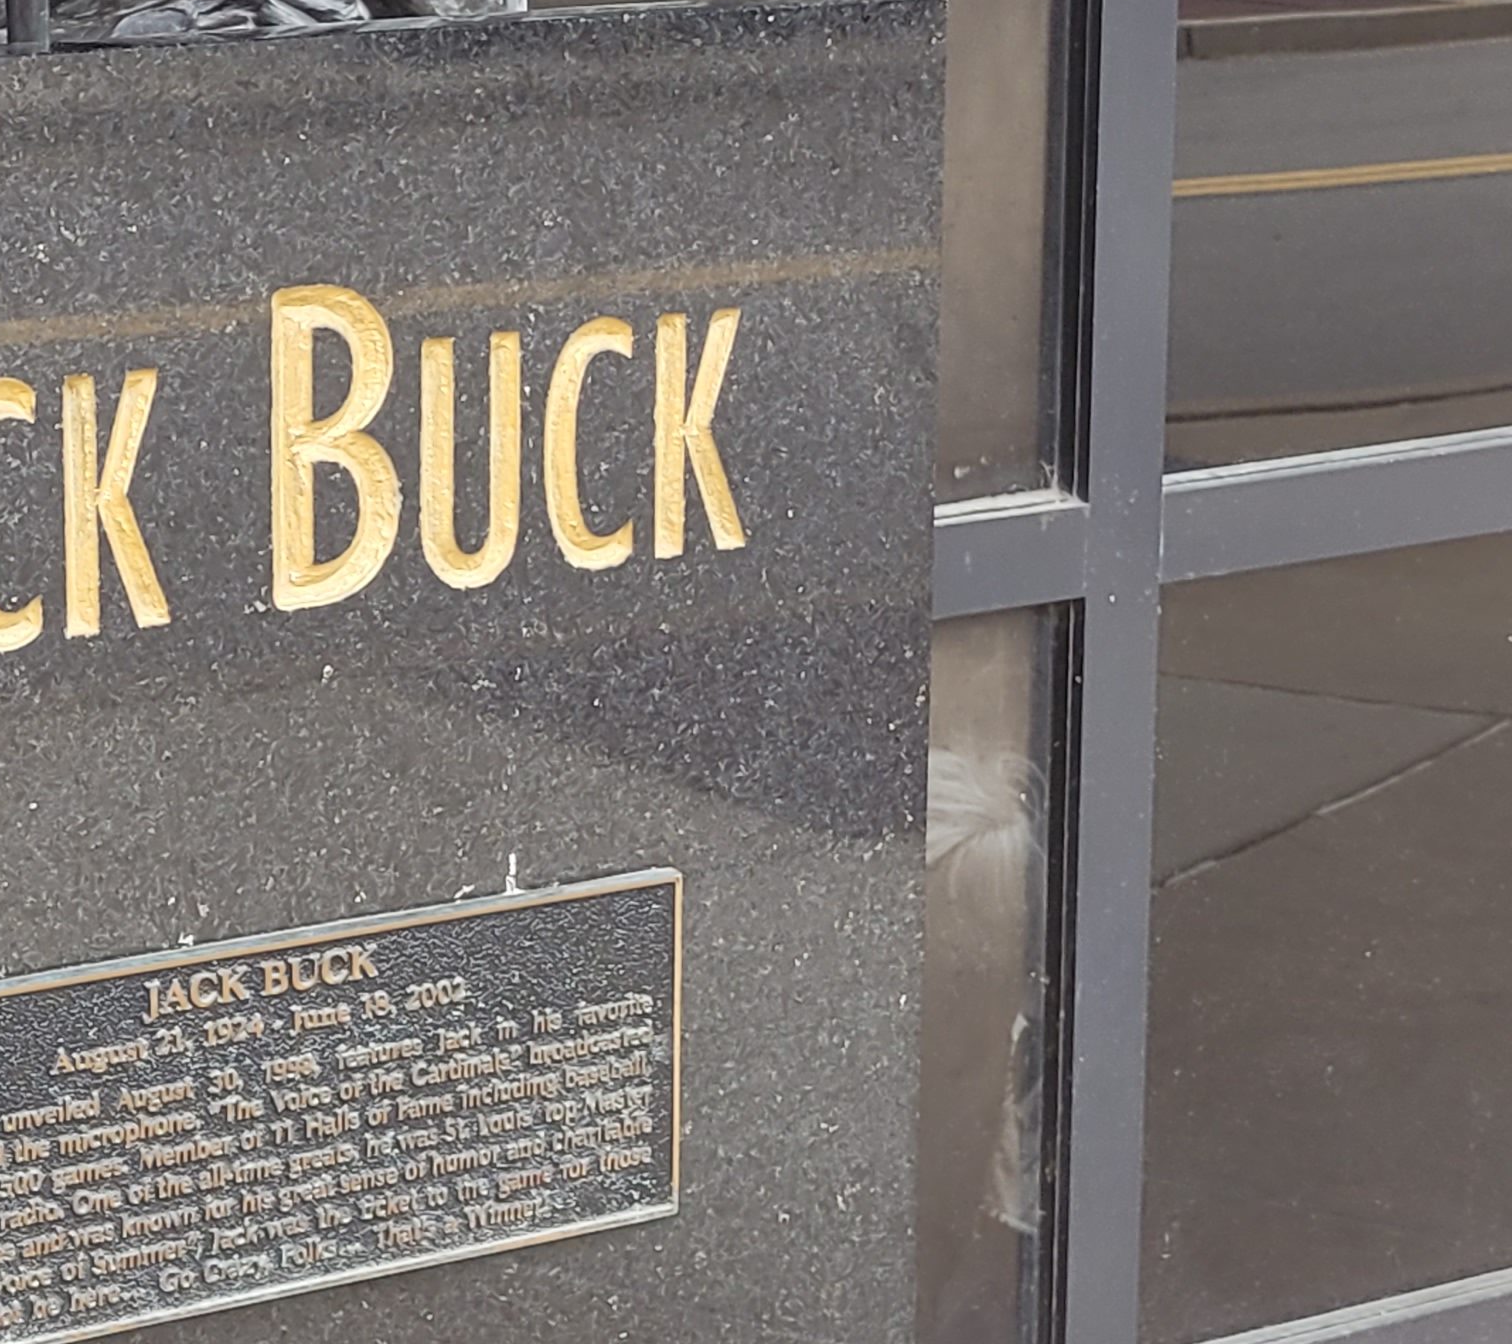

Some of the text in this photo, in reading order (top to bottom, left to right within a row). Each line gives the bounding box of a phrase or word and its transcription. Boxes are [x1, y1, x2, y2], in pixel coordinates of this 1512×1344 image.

[270, 283, 747, 612] BUCK
[49, 1032, 149, 1080] August
[201, 1011, 265, 1047] 1924
[288, 996, 351, 1036] June
[404, 975, 466, 1011] 2002
[142, 944, 379, 1023] JACK BUCK
[0, 1092, 100, 1132] unveiled
[116, 1076, 193, 1116] August
[334, 1032, 423, 1071] features
[436, 1022, 481, 1052] Jack
[496, 1012, 517, 1041] in
[531, 1006, 562, 1033] his
[573, 990, 653, 1026] favorite
[12, 1135, 50, 1162] the
[268, 1081, 332, 1114] Voice
[338, 1074, 362, 1101] of
[368, 1068, 402, 1095] the
[526, 1018, 653, 1065] broadcasted
[134, 1131, 230, 1171] Member
[238, 1124, 263, 1152] of
[303, 1106, 359, 1139] Halls
[367, 1098, 392, 1127] of
[396, 1091, 451, 1121] Fame
[456, 1068, 555, 1114] including
[20, 1226, 66, 1259] and
[68, 1222, 114, 1249] was
[117, 1201, 199, 1239] known
[202, 1193, 237, 1221] for
[239, 1186, 274, 1214] his
[278, 1175, 338, 1212] great
[339, 1165, 399, 1194] sense
[404, 1154, 427, 1182] of
[429, 1141, 501, 1177] humor
[505, 1132, 546, 1161] and
[550, 1109, 652, 1152] charitable
[59, 1251, 86, 1283] of
[206, 1219, 262, 1255] Jack
[263, 1214, 310, 1241] was
[315, 1200, 354, 1229] the
[425, 1181, 448, 1208] to
[456, 1173, 489, 1201] the
[497, 1164, 553, 1198] game
[559, 1154, 589, 1180] for
[598, 1141, 652, 1173] those
[71, 1184, 121, 1217] One
[127, 1175, 153, 1206] of
[157, 1170, 192, 1199] the
[364, 1128, 394, 1159] he
[395, 1125, 439, 1152] was
[583, 1081, 653, 1117] Master
